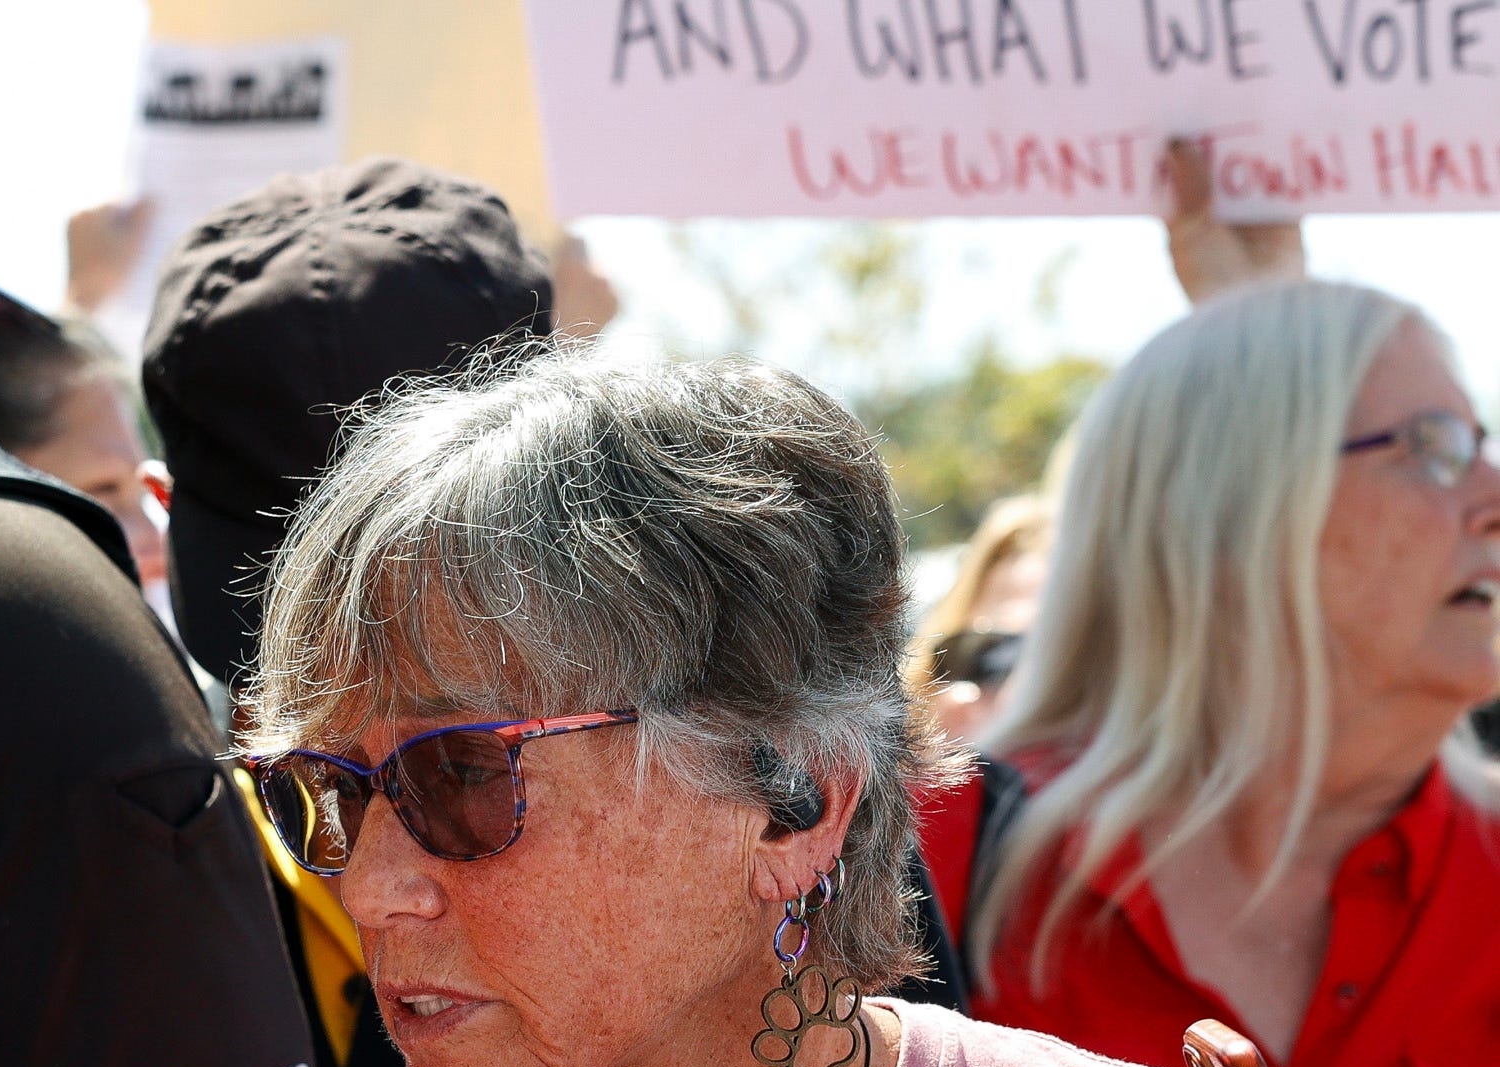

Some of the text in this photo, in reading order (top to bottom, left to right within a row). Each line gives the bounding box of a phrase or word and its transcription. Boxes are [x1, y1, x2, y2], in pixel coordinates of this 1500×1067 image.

[611, 0, 1500, 85] AND WHAT WE VOTE
[786, 123, 932, 201] WE
[940, 122, 1161, 197] WANT
[1370, 114, 1500, 201] HAL
